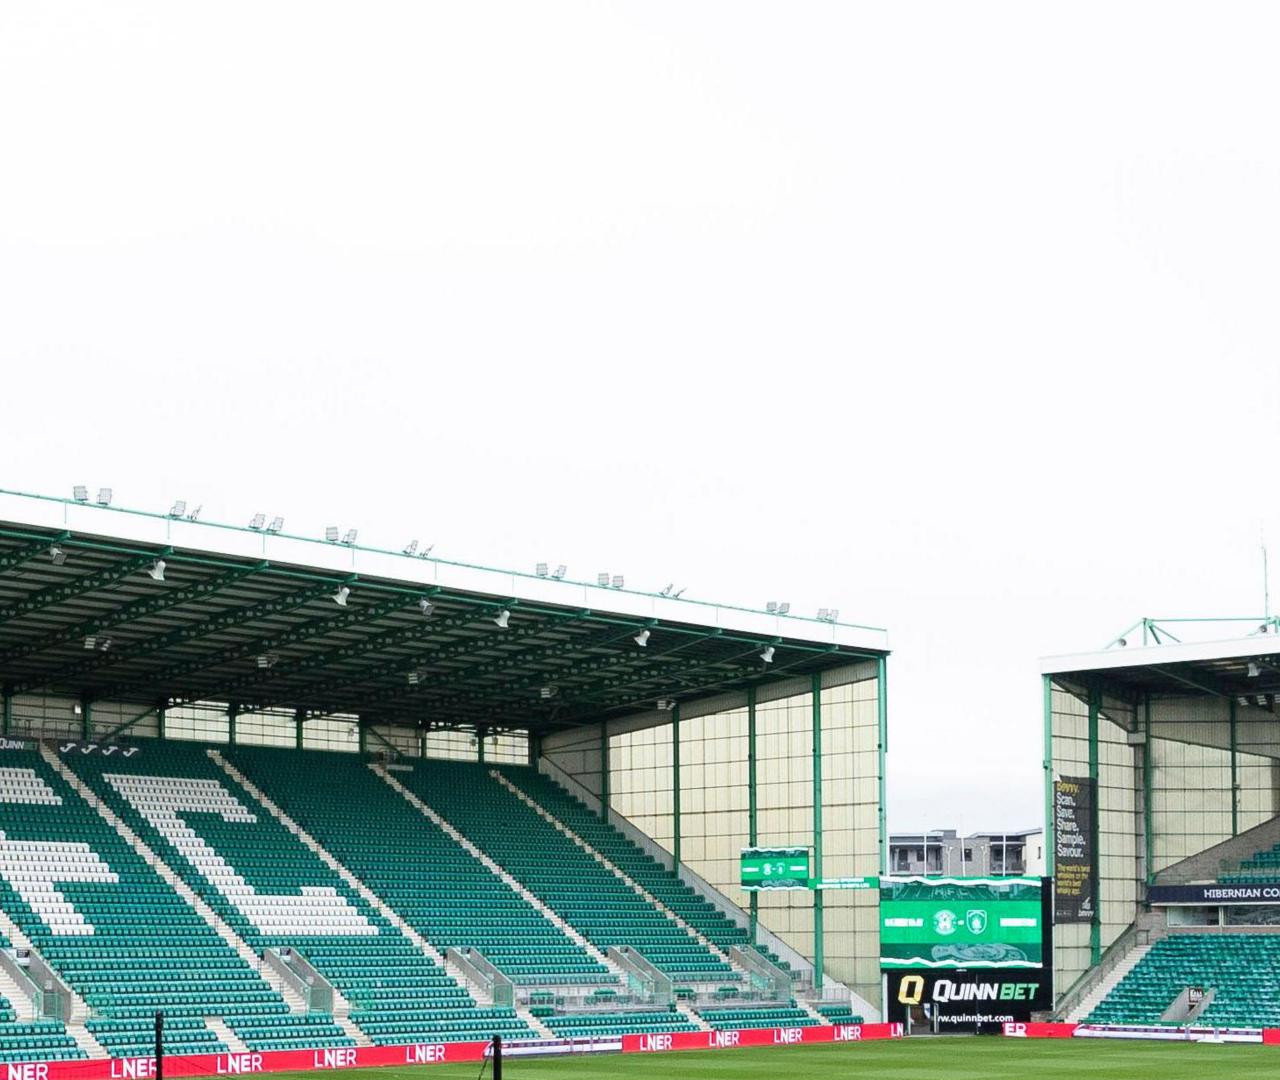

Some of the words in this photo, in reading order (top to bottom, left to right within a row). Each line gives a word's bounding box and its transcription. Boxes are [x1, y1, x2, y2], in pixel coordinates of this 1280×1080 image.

[1056, 792, 1076, 806] Scan.
[1056, 805, 1075, 818] Save.
[1056, 818, 1079, 832] Share.
[1056, 831, 1086, 846] Sample.
[1057, 844, 1084, 858] Savour.
[1204, 887, 1261, 898] HIBERNIAN
[897, 975, 924, 1004] Q
[932, 979, 1040, 1003] QUINNBET
[773, 1028, 803, 1044] LNER
[834, 1026, 862, 1041] LNER
[1004, 1023, 1027, 1038] ER
[640, 1033, 673, 1051] LNER
[709, 1029, 740, 1048] LNER
[314, 1049, 357, 1069] LNER
[406, 1043, 446, 1064] LNER
[217, 1053, 263, 1075] LNER
